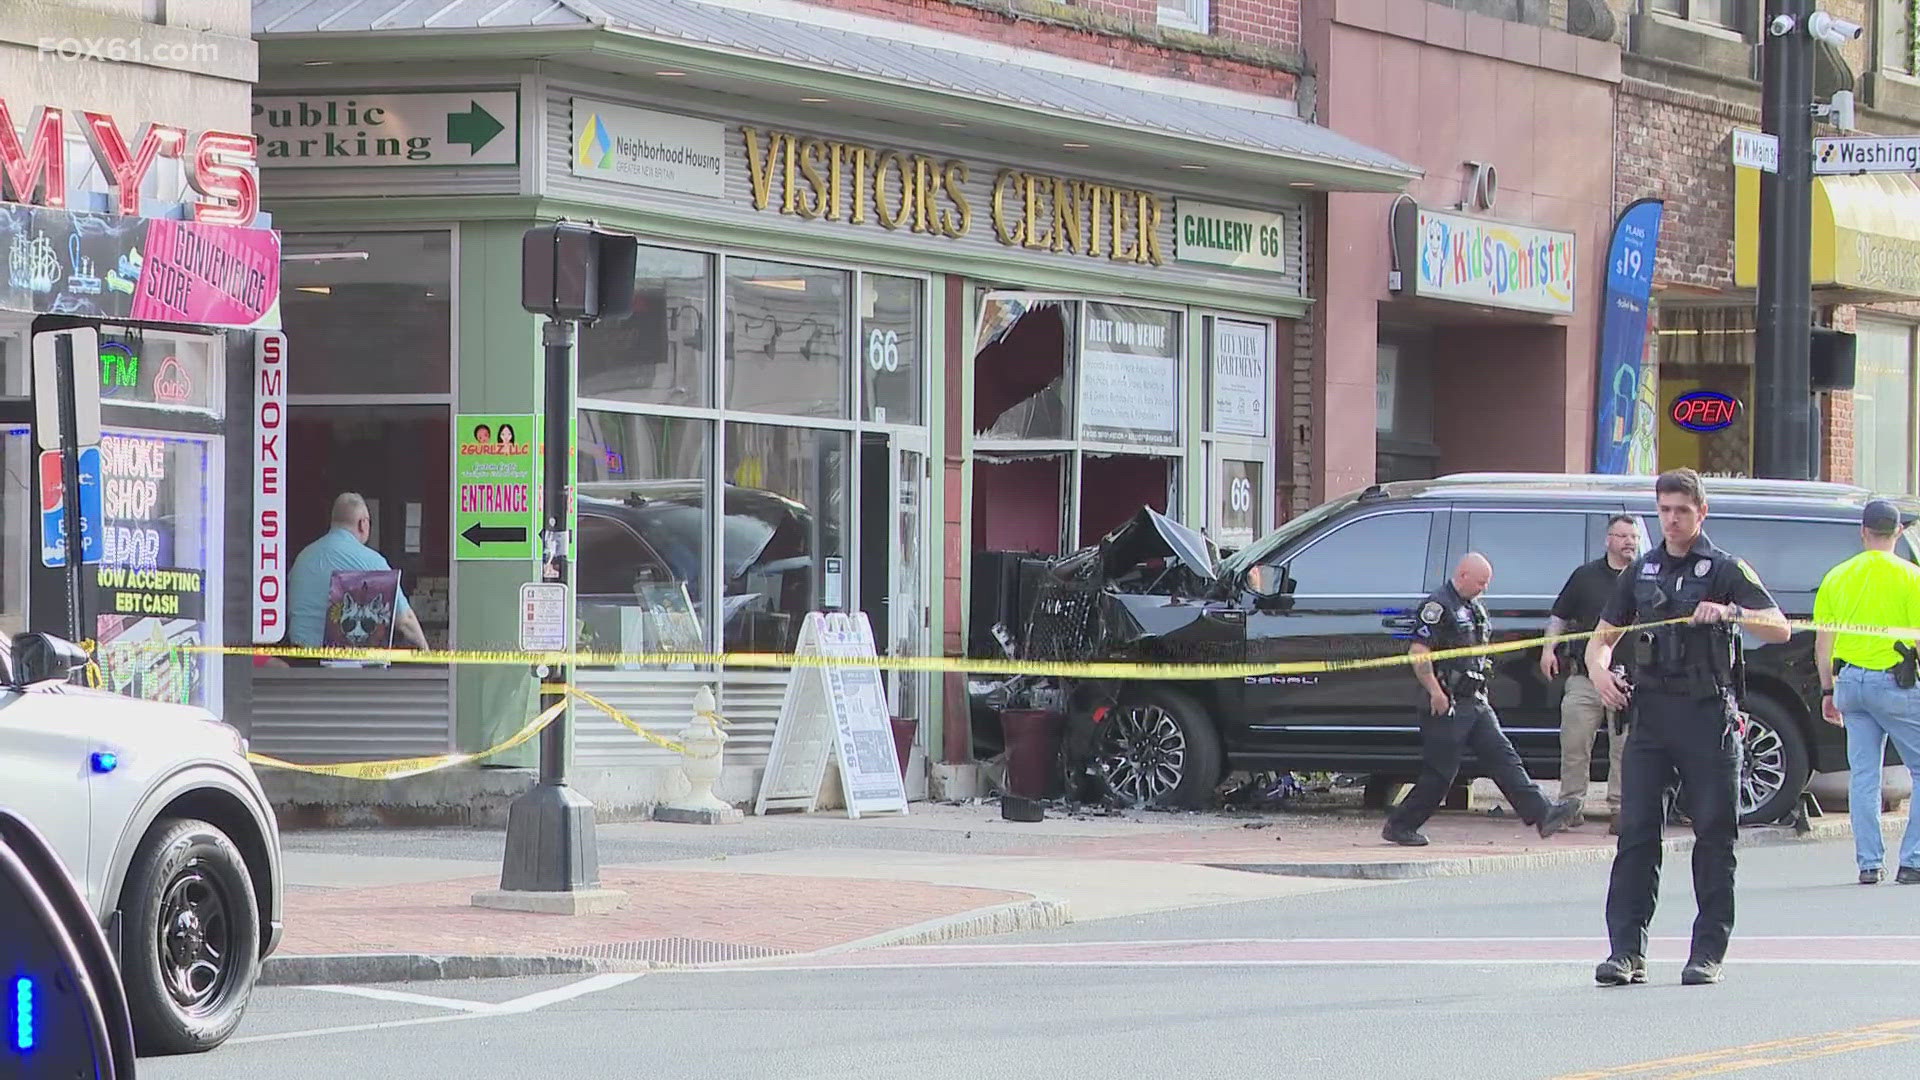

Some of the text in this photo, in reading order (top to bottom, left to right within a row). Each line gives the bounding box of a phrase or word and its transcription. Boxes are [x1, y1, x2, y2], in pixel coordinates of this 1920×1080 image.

[616, 136, 721, 175] Neighborhood Housing
[1752, 140, 1770, 163] Main
[616, 161, 641, 175] GREATER
[655, 168, 675, 181] BRITAIN
[1462, 159, 1498, 210] 70
[742, 126, 1164, 267] VISITORS CENTER
[1183, 214, 1280, 258] GALLERY 66
[1625, 224, 1646, 239] PLANS
[174, 222, 266, 314] CONVENIENCE
[1495, 236, 1572, 293] Dentistry
[1615, 246, 1642, 279] $19
[147, 255, 193, 316] STORE
[868, 328, 900, 372] 66
[1089, 318, 1166, 349] RENT OUR VENUE
[1220, 333, 1257, 357] CITY VIEW
[99, 354, 138, 387] TM
[1216, 354, 1262, 379] APARTMENTS
[1673, 400, 1737, 424] OPEN
[100, 435, 165, 480] SMOKE
[509, 444, 529, 455] LLC
[105, 479, 157, 521] SHOP
[258, 336, 281, 635] SMOKE SHOP
[461, 484, 528, 513] ENTRANCE
[1231, 477, 1251, 512] 66
[126, 568, 200, 593] ACCEPTING
[115, 591, 179, 614] EBT CASH
[1243, 676, 1318, 685] DENALI
